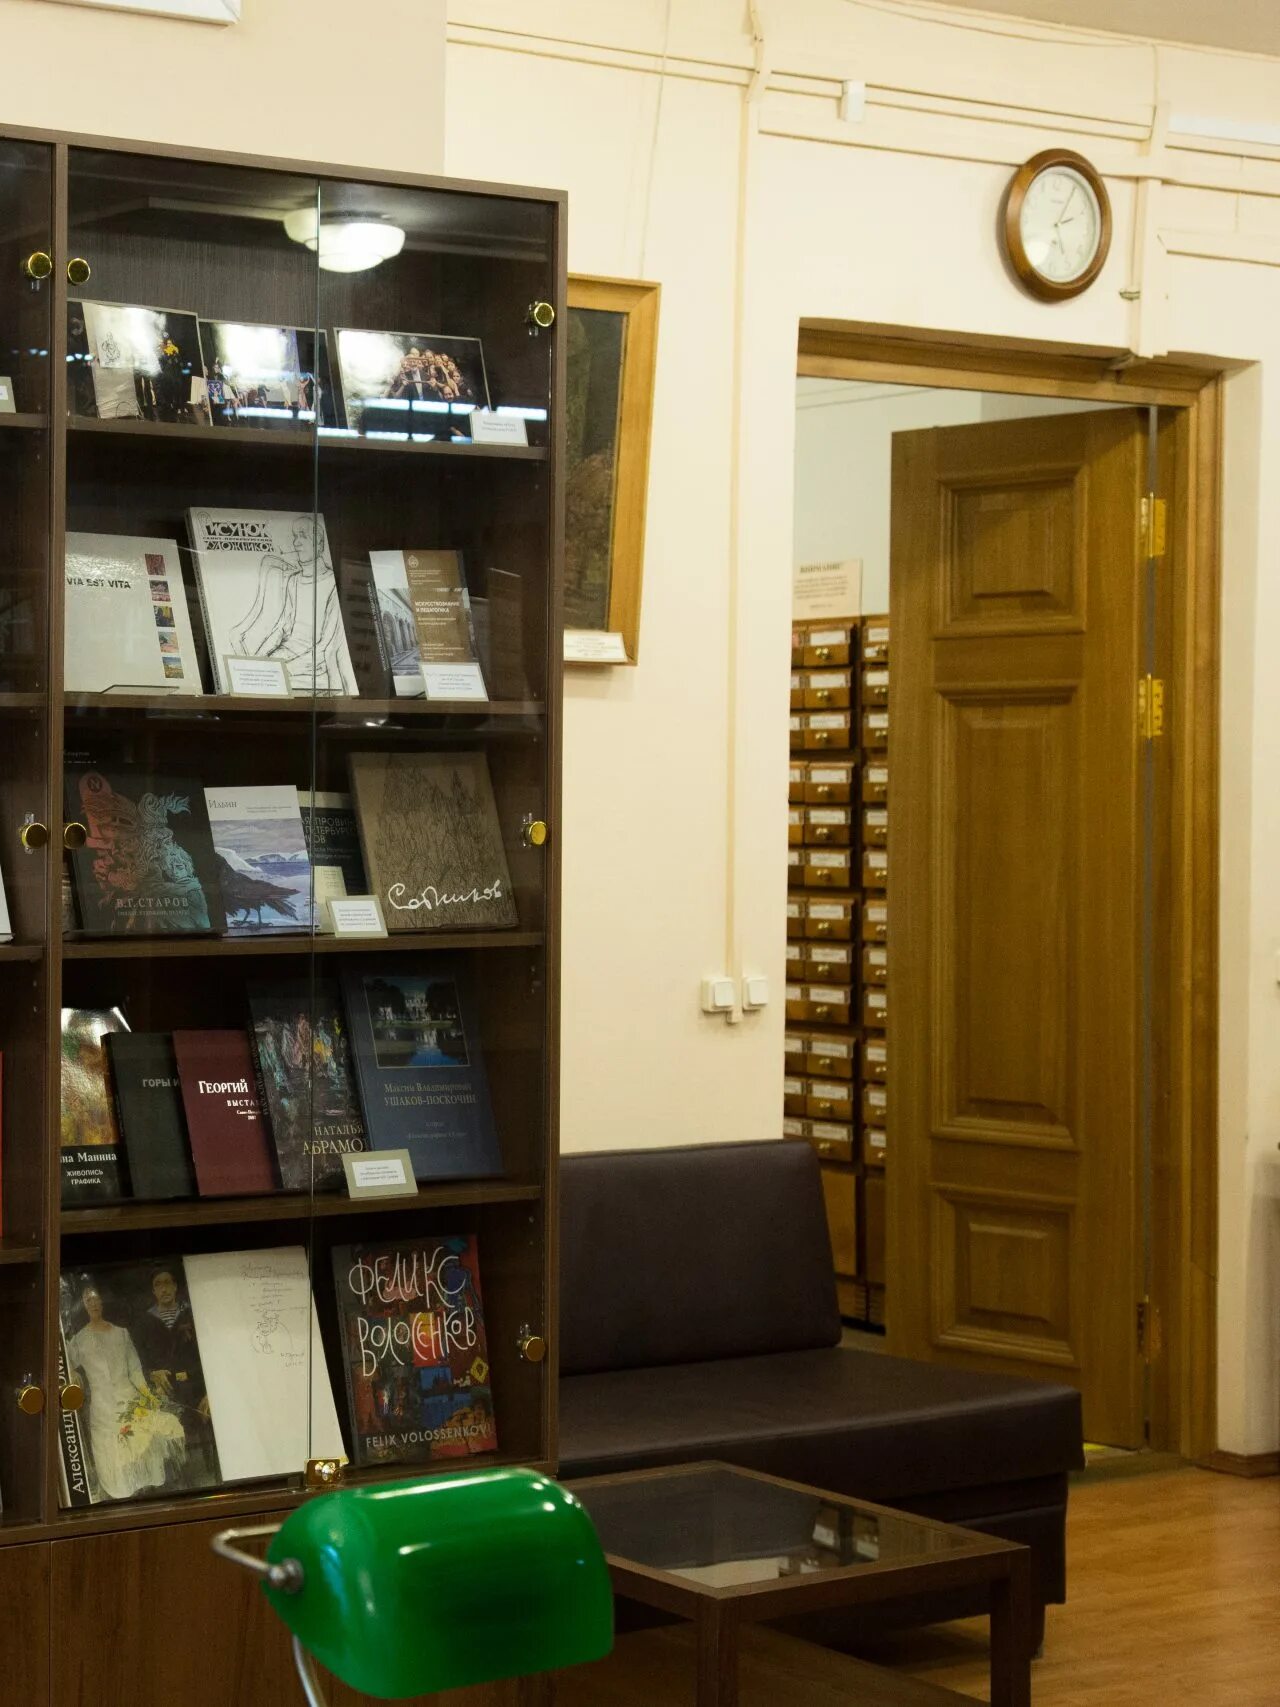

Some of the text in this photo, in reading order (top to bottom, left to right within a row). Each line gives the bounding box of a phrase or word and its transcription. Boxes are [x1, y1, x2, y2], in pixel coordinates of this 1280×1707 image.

[67, 578, 131, 589] VIA EST VITA
[142, 1078, 171, 1088] ГОРЫ
[314, 1125, 364, 1136] НАТАЛЬЯ
[302, 1138, 366, 1156] АБРАМО
[77, 1152, 117, 1162] Манина
[66, 1169, 104, 1177] ЖИВОПИСЬ
[71, 1177, 101, 1186] ГРАФИКА
[348, 1246, 466, 1309] ФЕЛИКС
[365, 1425, 487, 1449] FELIX VOLOSSENKOV
[63, 1409, 86, 1495] Александ
